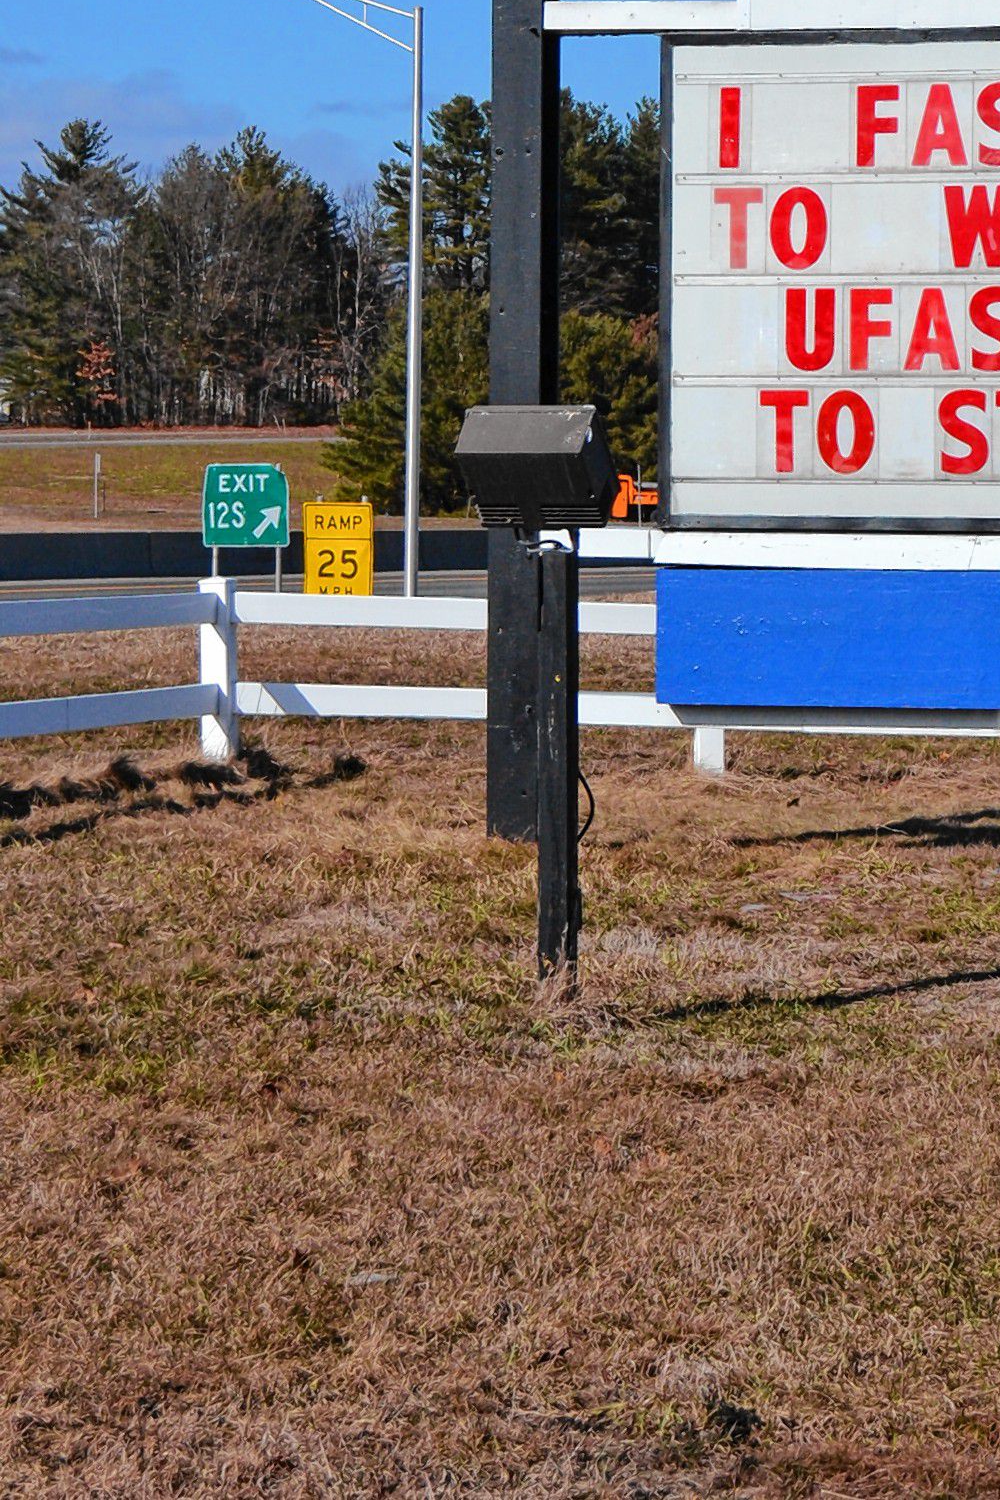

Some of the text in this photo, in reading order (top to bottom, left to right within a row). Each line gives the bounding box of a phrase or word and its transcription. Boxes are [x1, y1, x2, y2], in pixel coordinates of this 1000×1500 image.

[718, 86, 741, 169] I
[713, 186, 829, 270] TO
[759, 389, 876, 477] TO
[218, 473, 270, 493] EXIT
[208, 501, 247, 530] 12S
[314, 515, 363, 531] RAMP
[317, 549, 358, 580] 25
